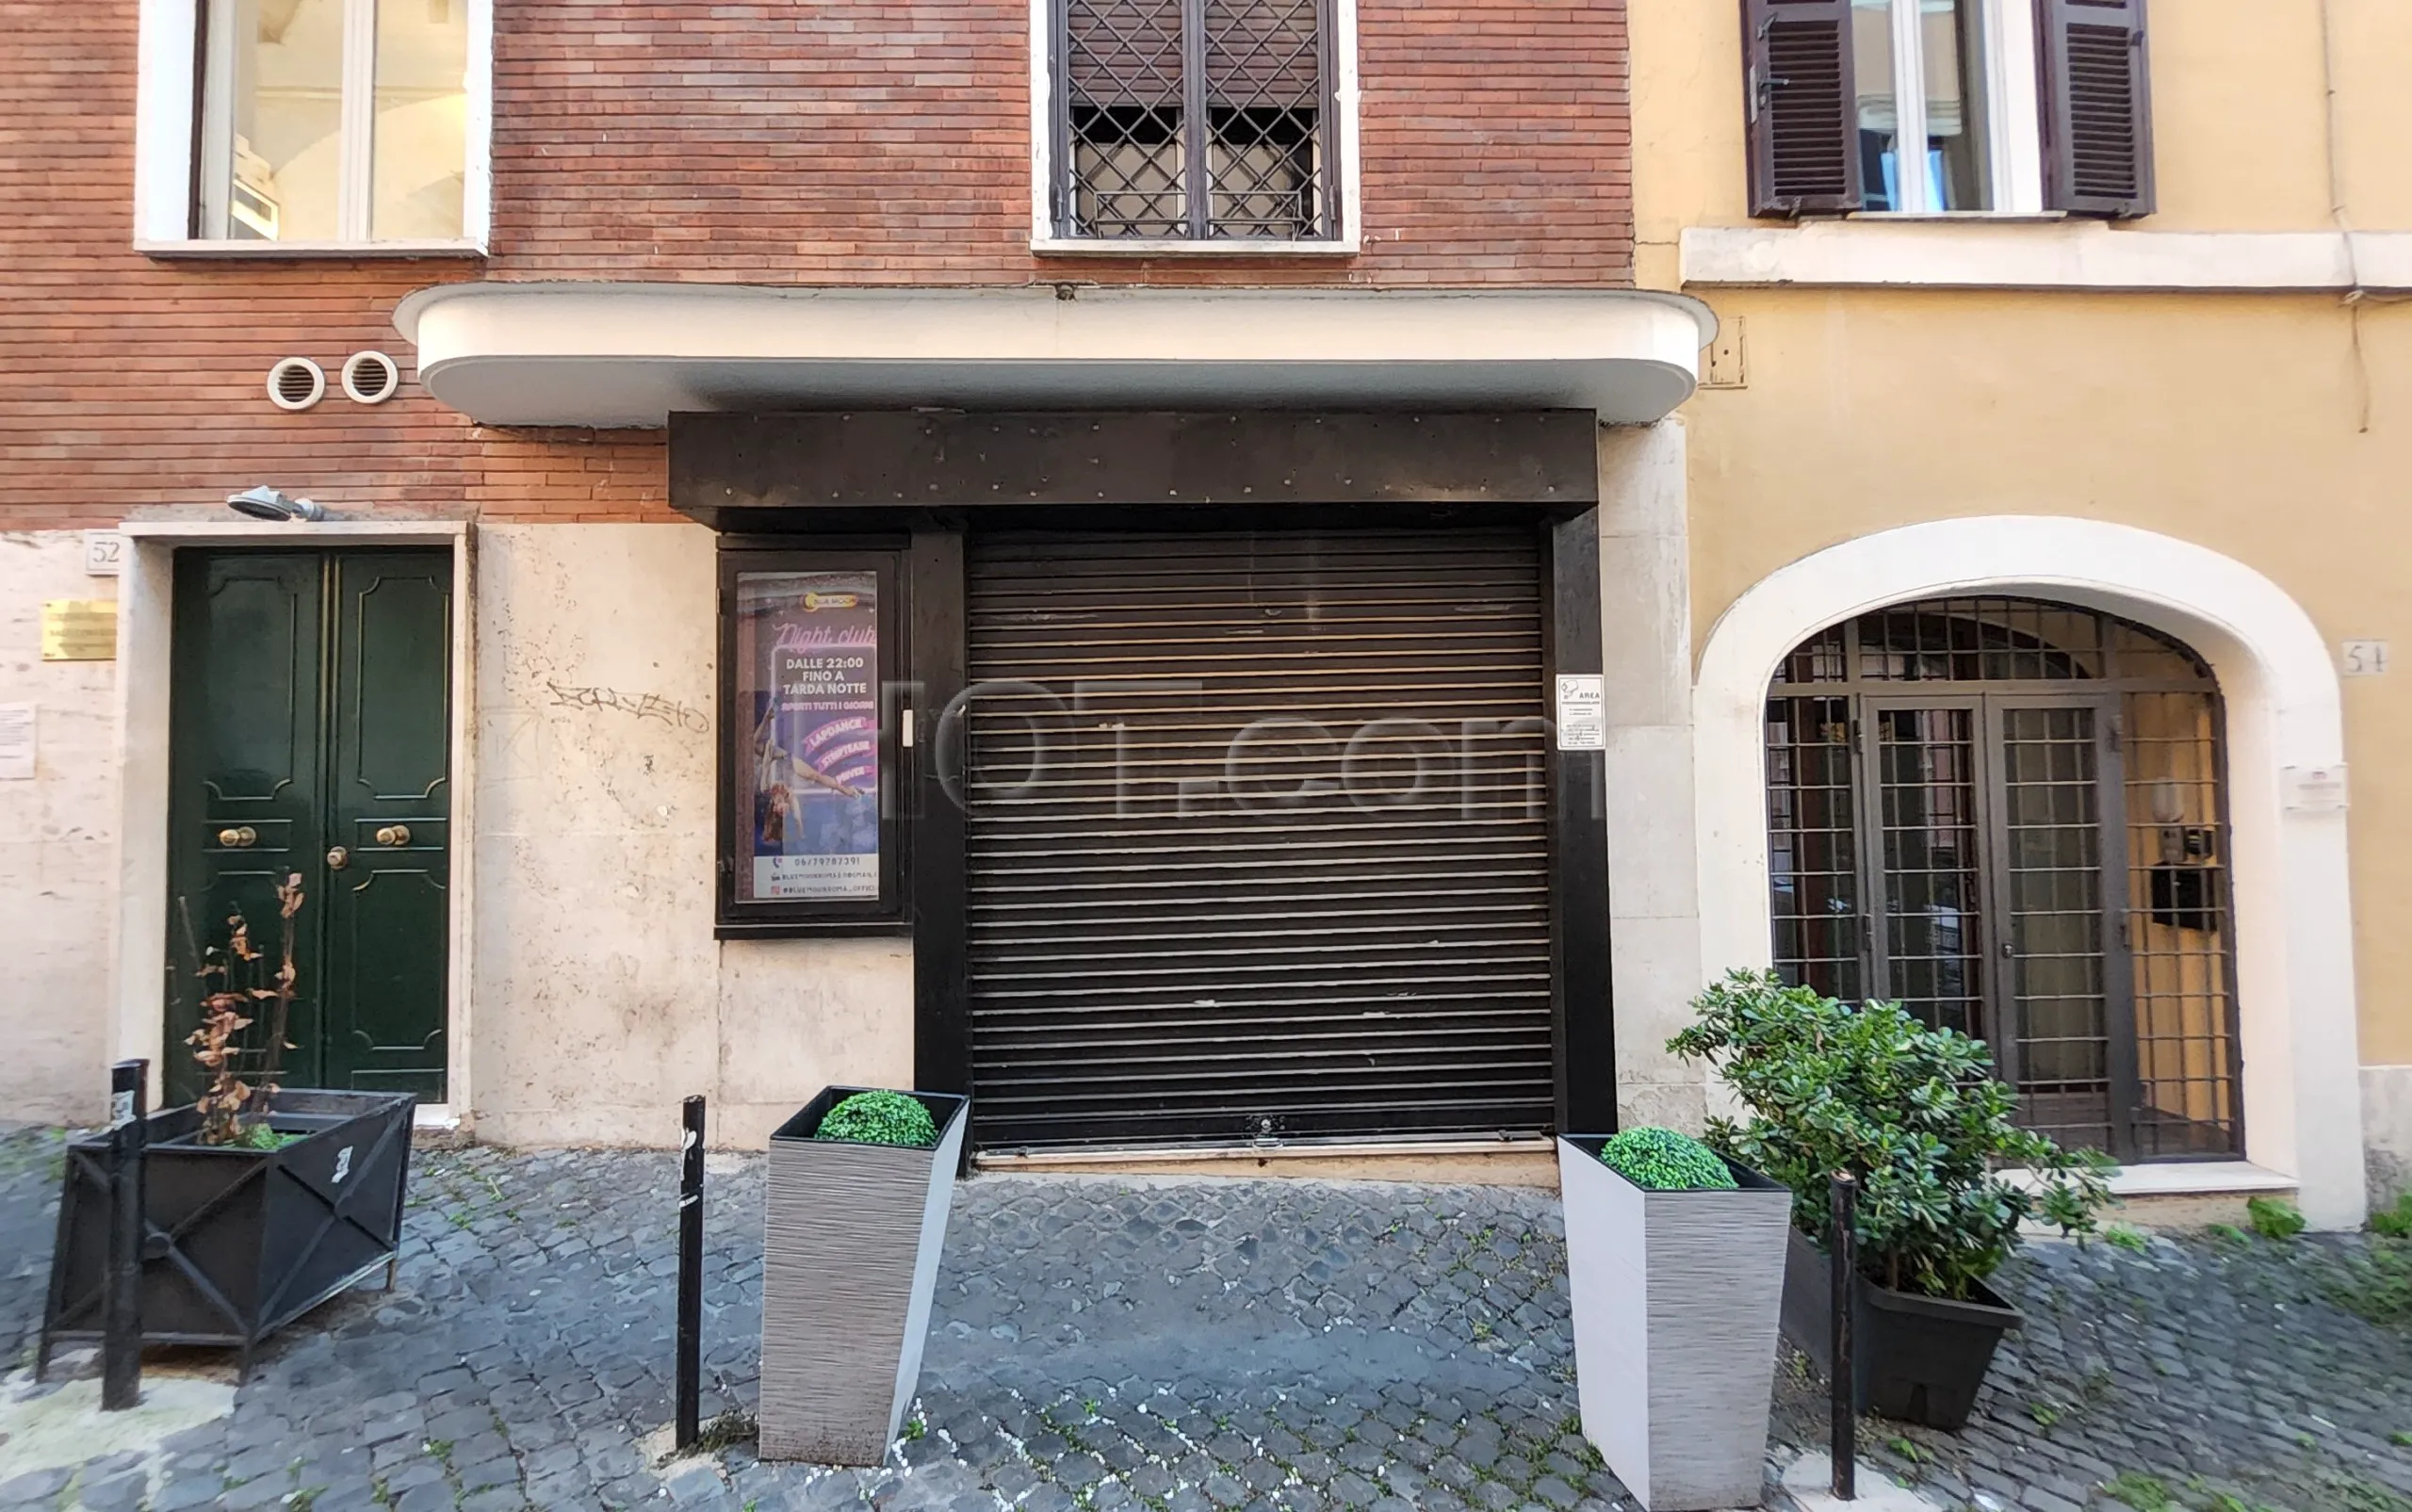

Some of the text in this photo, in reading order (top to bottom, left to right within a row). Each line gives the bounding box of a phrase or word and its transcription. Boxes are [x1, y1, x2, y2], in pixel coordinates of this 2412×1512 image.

[92, 541, 121, 563] 52
[772, 622, 876, 653] Night club
[786, 657, 864, 670] DALLE 22:00
[802, 670, 845, 682] FINO A
[783, 682, 867, 695] TARDA NOTTE
[812, 701, 838, 710] TUTTI
